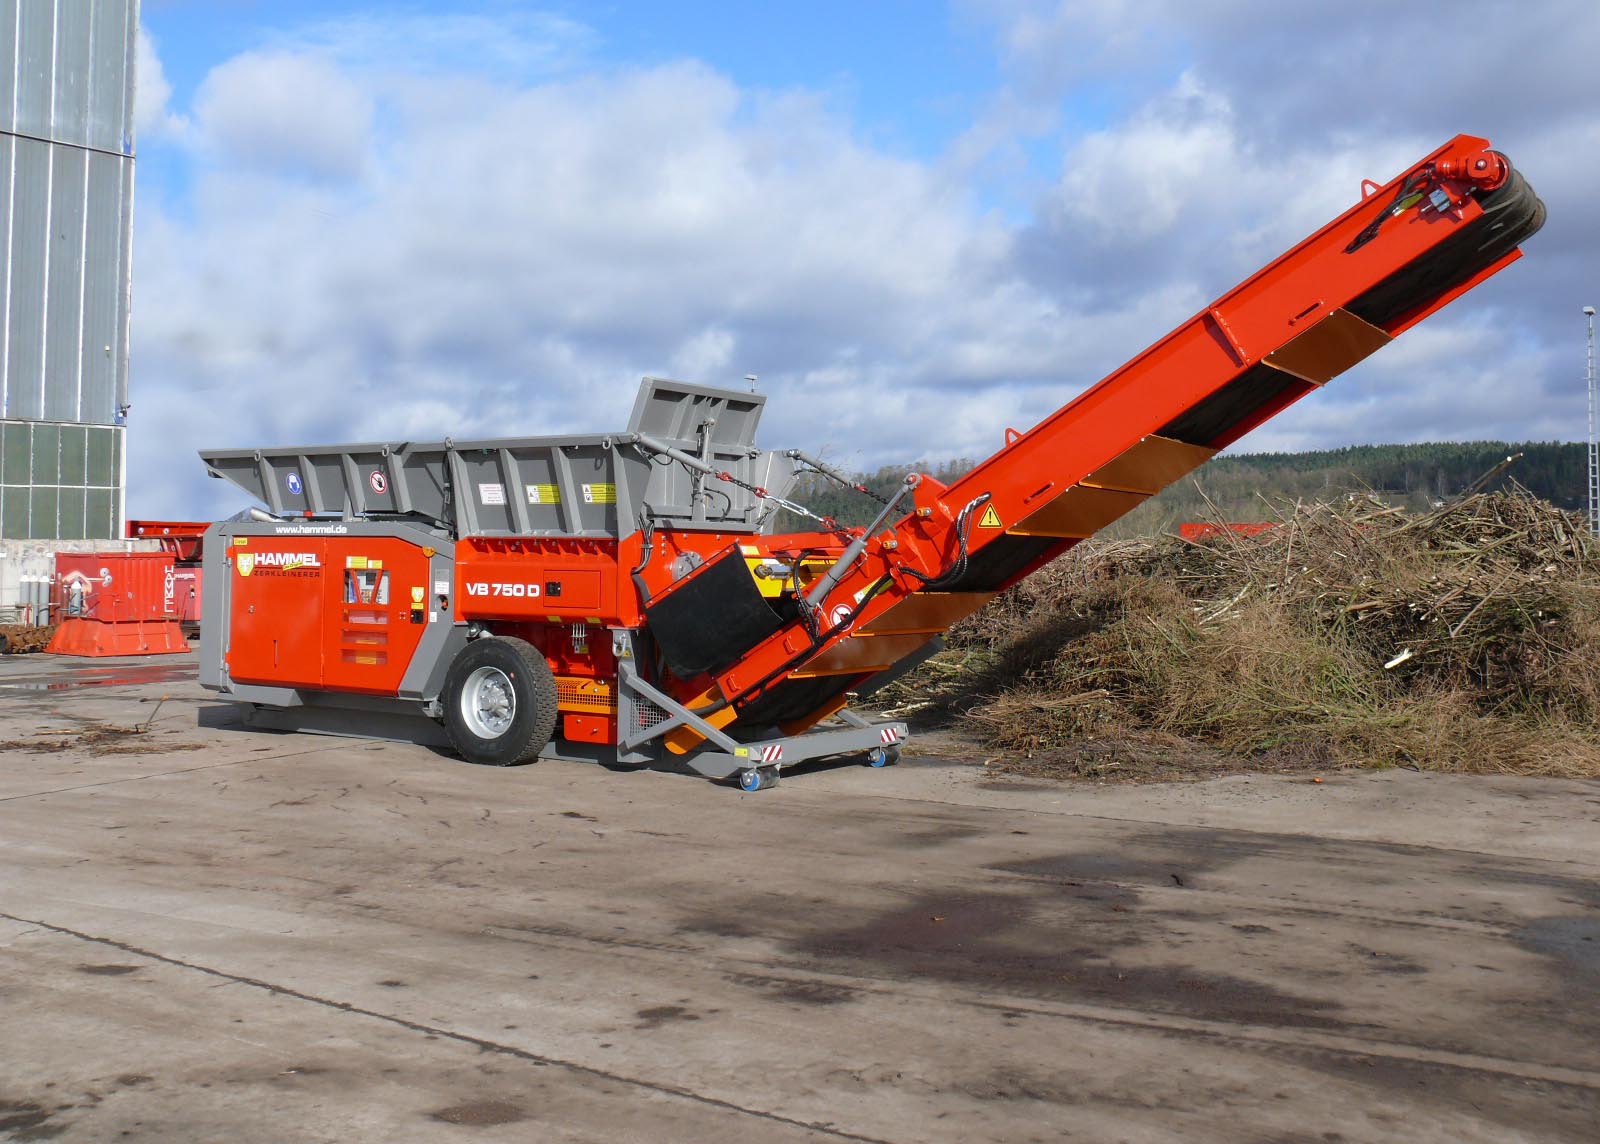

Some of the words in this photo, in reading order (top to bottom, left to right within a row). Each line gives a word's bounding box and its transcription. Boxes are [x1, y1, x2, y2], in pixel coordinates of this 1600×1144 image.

[275, 525, 347, 534] www.hammel.de
[254, 552, 320, 567] HAMMEL
[164, 565, 174, 613] HAMMEL
[465, 582, 489, 596] VB
[491, 583, 525, 597] 750
[527, 584, 540, 597] D
